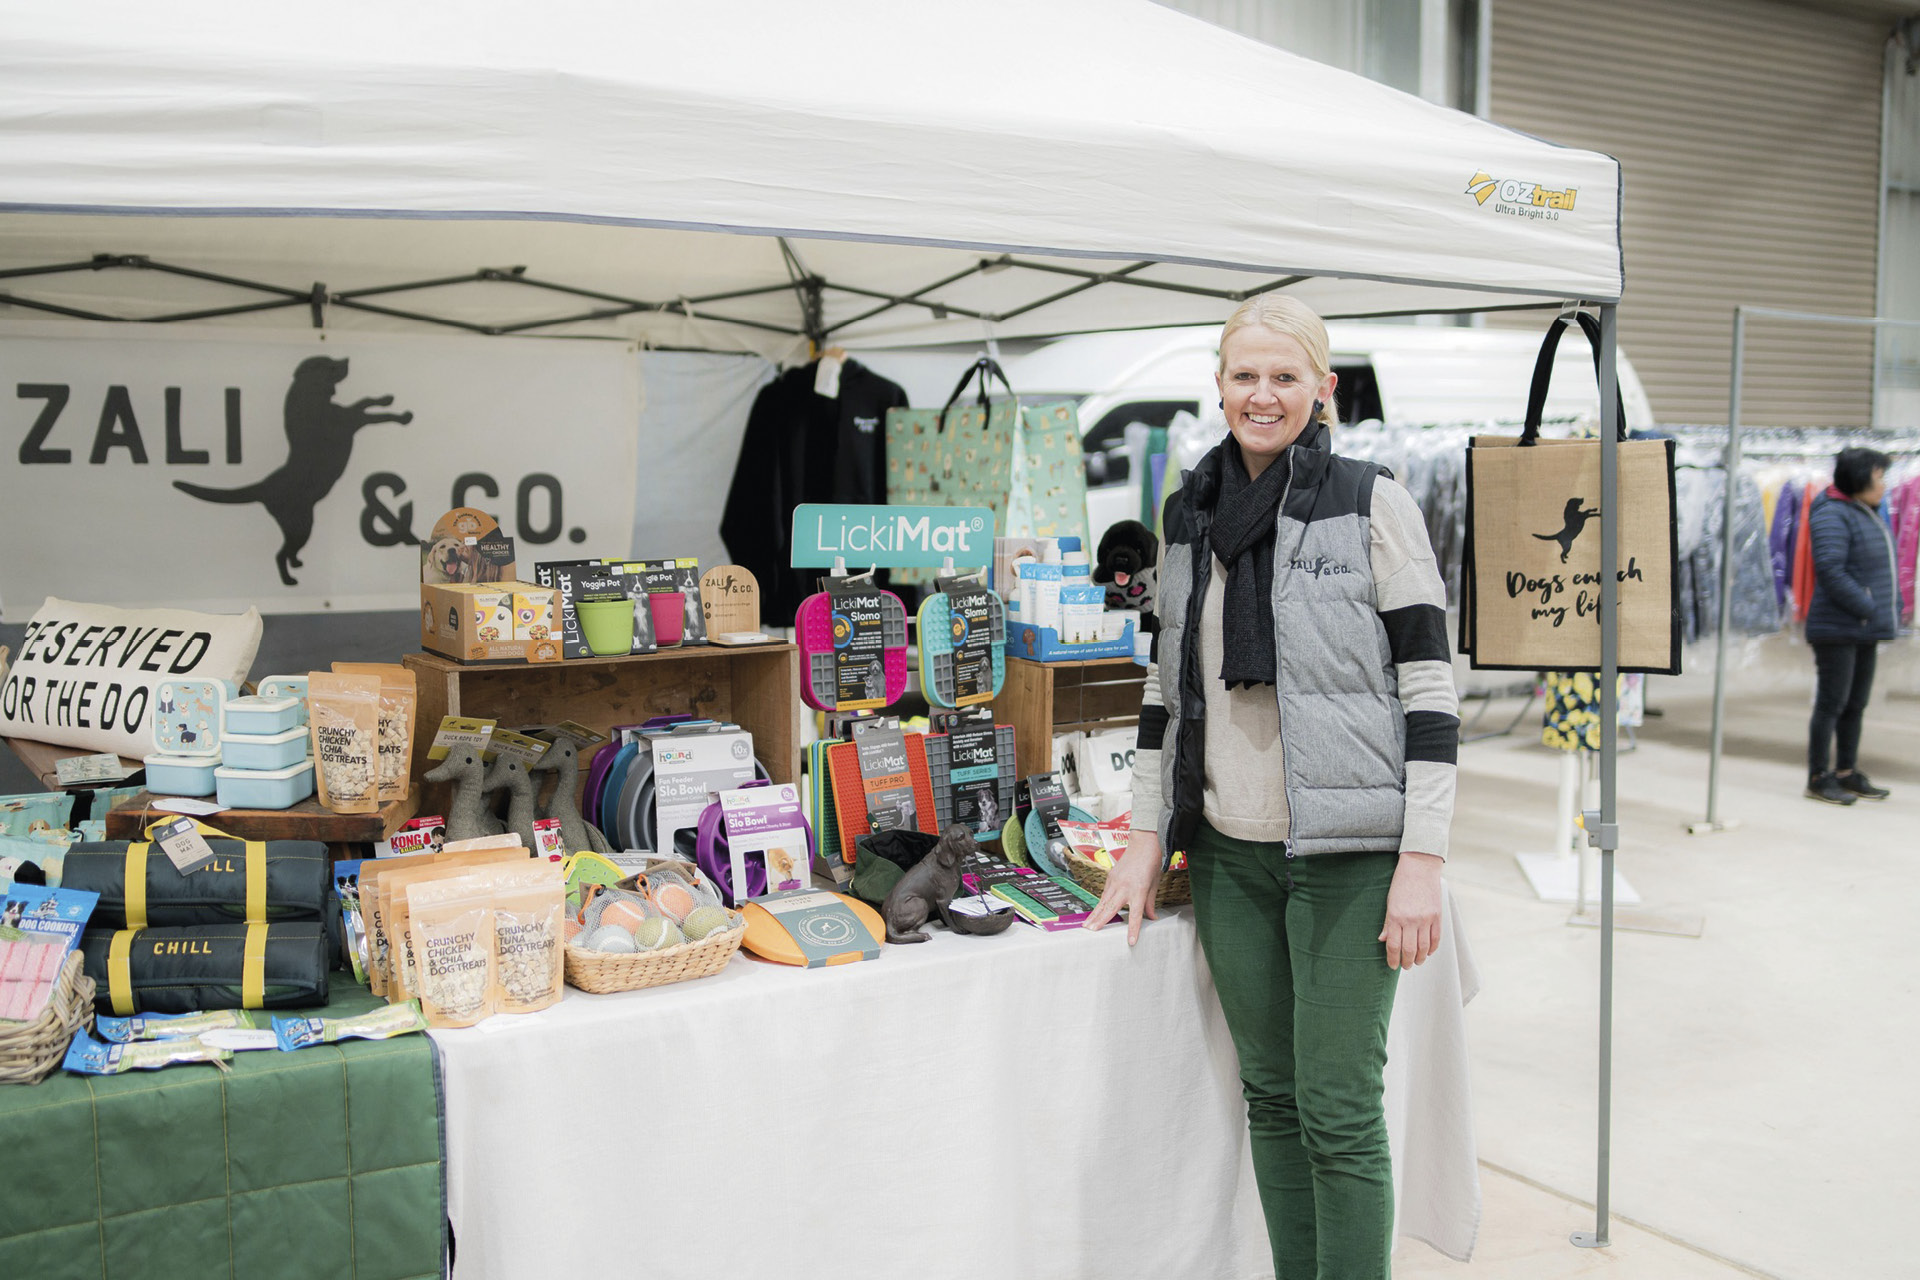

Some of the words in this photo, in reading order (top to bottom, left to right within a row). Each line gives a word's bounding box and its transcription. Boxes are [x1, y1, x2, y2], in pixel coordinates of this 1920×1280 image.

[1500, 179, 1577, 211] OZtrail
[1495, 204, 1516, 215] Ultra
[1518, 207, 1544, 219] Bright
[1546, 211, 1559, 221] 3.0
[17, 383, 242, 465] ZALI
[359, 471, 420, 547] &
[481, 543, 509, 551] HEALTHY
[1290, 560, 1312, 570] ZALI
[1333, 565, 1350, 575] CO.
[581, 580, 606, 590] Yoggie
[607, 579, 621, 587] Pot
[659, 574, 673, 582] Pot
[1506, 571, 1566, 604] Dogs
[1572, 557, 1643, 585] ench
[705, 578, 724, 587] ZALI
[732, 585, 738, 593] &
[740, 585, 754, 593] CO.
[559, 573, 580, 644] LickiMat
[834, 596, 880, 610] LickiMat
[951, 594, 987, 610] LickiMat
[1531, 606, 1569, 627] my
[1576, 590, 1622, 625] lif
[850, 611, 881, 622] Slomo
[964, 608, 988, 619] Slomo
[16, 621, 212, 674] RESERVED
[3, 675, 36, 724] OR
[45, 679, 98, 728] THE
[100, 683, 152, 734] DO
[318, 726, 357, 738] CRUNCHY
[318, 735, 352, 746] CHICKEN
[324, 744, 343, 754] CHIA
[378, 745, 401, 754] EATS
[493, 743, 507, 751] DUCK
[507, 746, 522, 755] ROPE
[522, 751, 534, 759] TOY
[732, 743, 748, 754] 10x
[952, 747, 994, 762] LickiMat
[335, 754, 368, 765] TREATS
[659, 751, 692, 763] hound
[863, 754, 905, 772] LickiMat
[1110, 749, 1136, 772] DO
[972, 767, 993, 776] SERIES
[671, 776, 694, 784] Feeder
[870, 780, 889, 788] TUFF
[889, 776, 905, 784] PRO
[659, 785, 678, 797] Slo
[679, 782, 707, 795] Bowl
[1035, 785, 1062, 796] LickiMat
[728, 818, 744, 828] Slo
[745, 815, 768, 827] Bowl
[175, 838, 192, 849] DOG
[390, 832, 423, 850] KONG
[541, 833, 556, 847] KONG
[180, 844, 194, 854] MAT
[18, 918, 38, 929] DOG
[497, 922, 545, 937] CRUNCHY
[376, 929, 384, 938] &
[426, 932, 476, 948] CRUNCHY
[153, 940, 213, 955] CHILL
[498, 936, 526, 947] TUNA
[500, 945, 524, 955] DOG
[525, 938, 556, 951] TREATS
[406, 950, 415, 958] &
[427, 943, 472, 959] CHICKEN
[429, 959, 437, 967] &
[439, 955, 464, 966] CHIA
[430, 965, 456, 977] DOG
[455, 959, 487, 973] TREATS
